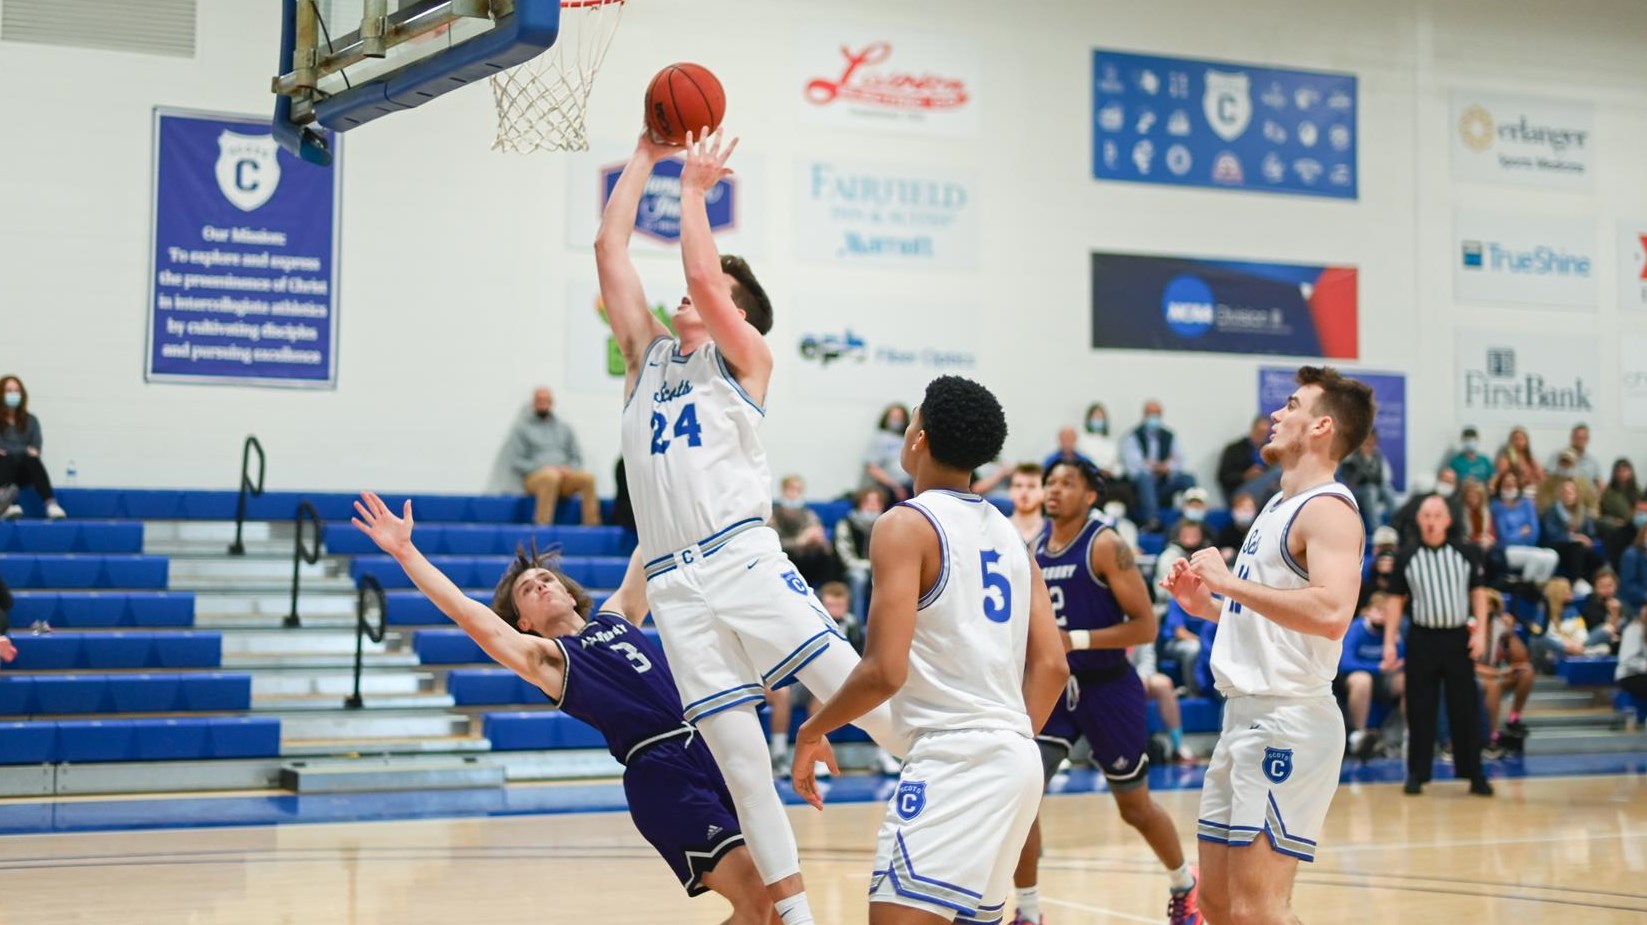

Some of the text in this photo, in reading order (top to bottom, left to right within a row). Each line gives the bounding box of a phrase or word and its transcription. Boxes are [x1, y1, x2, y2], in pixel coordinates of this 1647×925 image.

[1217, 93, 1236, 125] C
[1498, 114, 1586, 152] erlanger
[235, 159, 259, 191] C
[203, 225, 287, 246] Our Mission:
[169, 247, 321, 273] To explore and express
[1488, 242, 1590, 277] TrueShine
[159, 269, 182, 286] the
[273, 275, 287, 293] of
[288, 276, 328, 295] Christ
[158, 292, 328, 318] in intercollegiate athletics
[1167, 302, 1213, 324] NCAA
[166, 317, 318, 343] by cultivating disciples
[162, 341, 322, 365] and pursuing excellence
[1465, 370, 1592, 411] FirstBank
[651, 403, 702, 455] 24
[682, 550, 694, 564] C
[792, 578, 805, 591] C
[979, 549, 1012, 623] 5
[609, 642, 652, 674] 3
[1271, 760, 1285, 777] C
[902, 794, 917, 812] C
